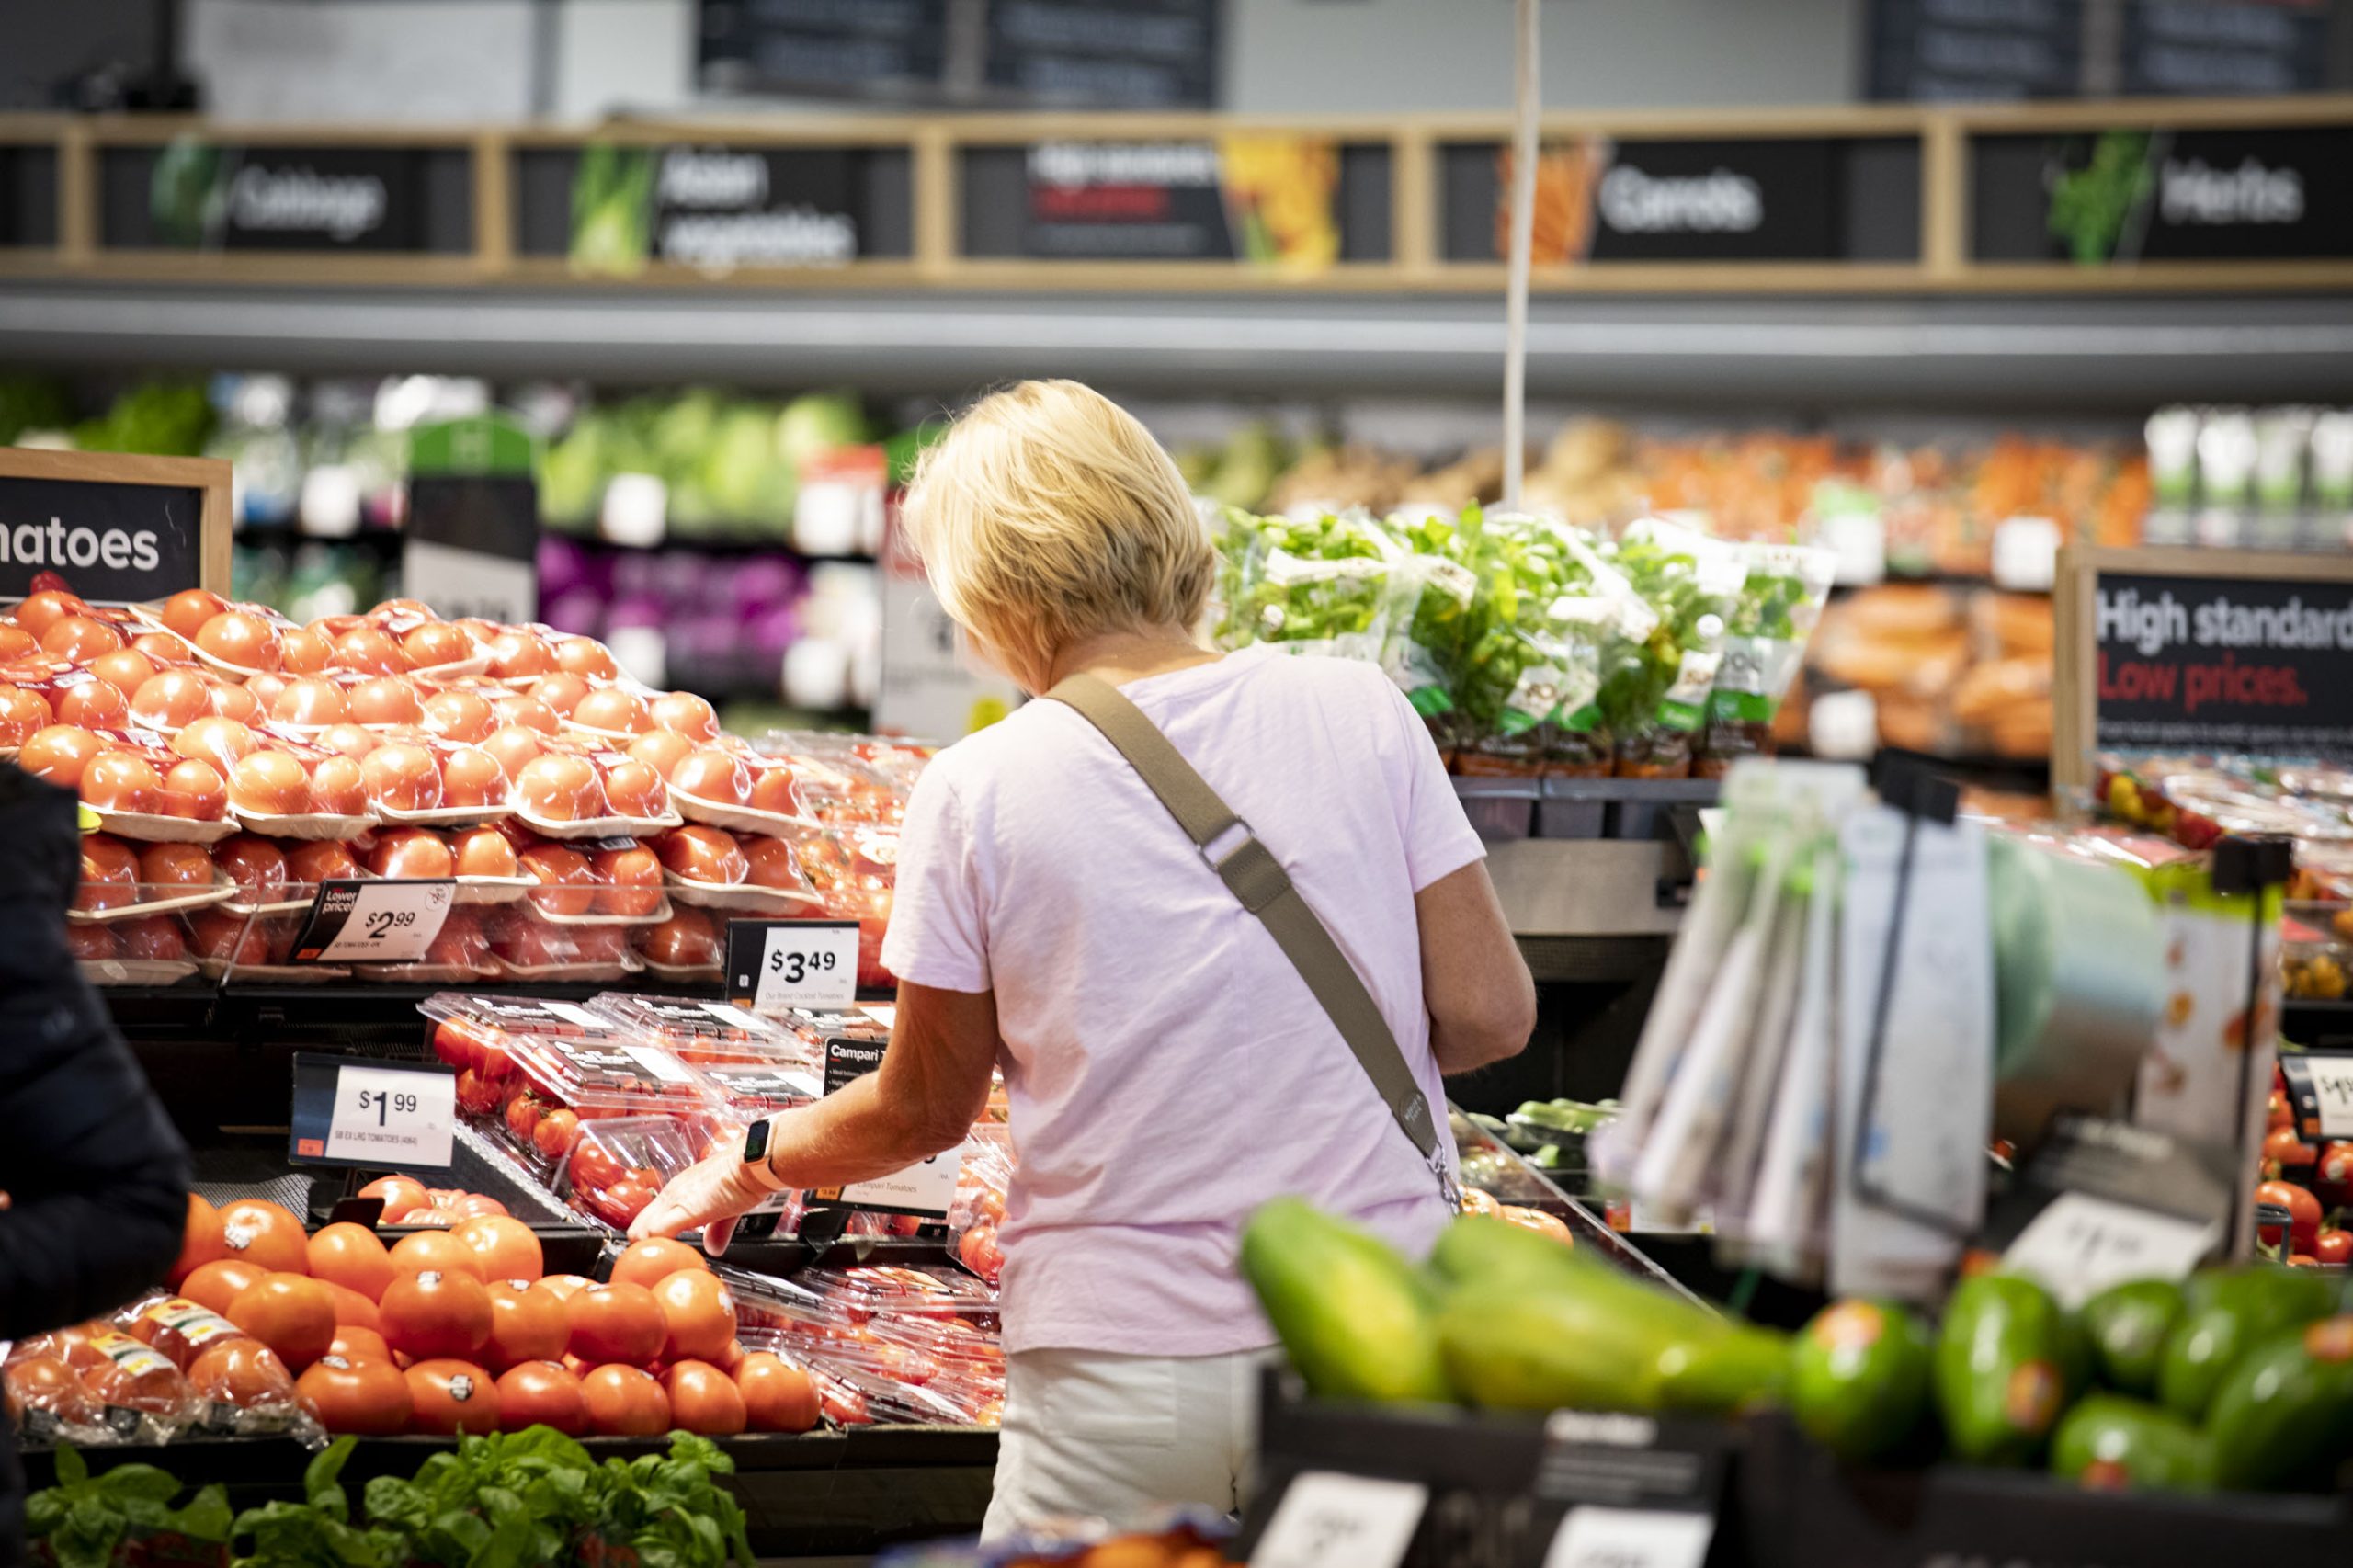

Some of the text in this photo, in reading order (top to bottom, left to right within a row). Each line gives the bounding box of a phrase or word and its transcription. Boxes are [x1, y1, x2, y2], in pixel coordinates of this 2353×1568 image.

[1600, 165, 1764, 232] Carrots
[0, 517, 160, 571] atoes
[2097, 586, 2188, 655] High
[2098, 649, 2308, 713] Low prices.
[326, 890, 358, 903] Lower
[831, 1044, 880, 1062] Campari
[886, 1182, 918, 1193] Tomatoes
